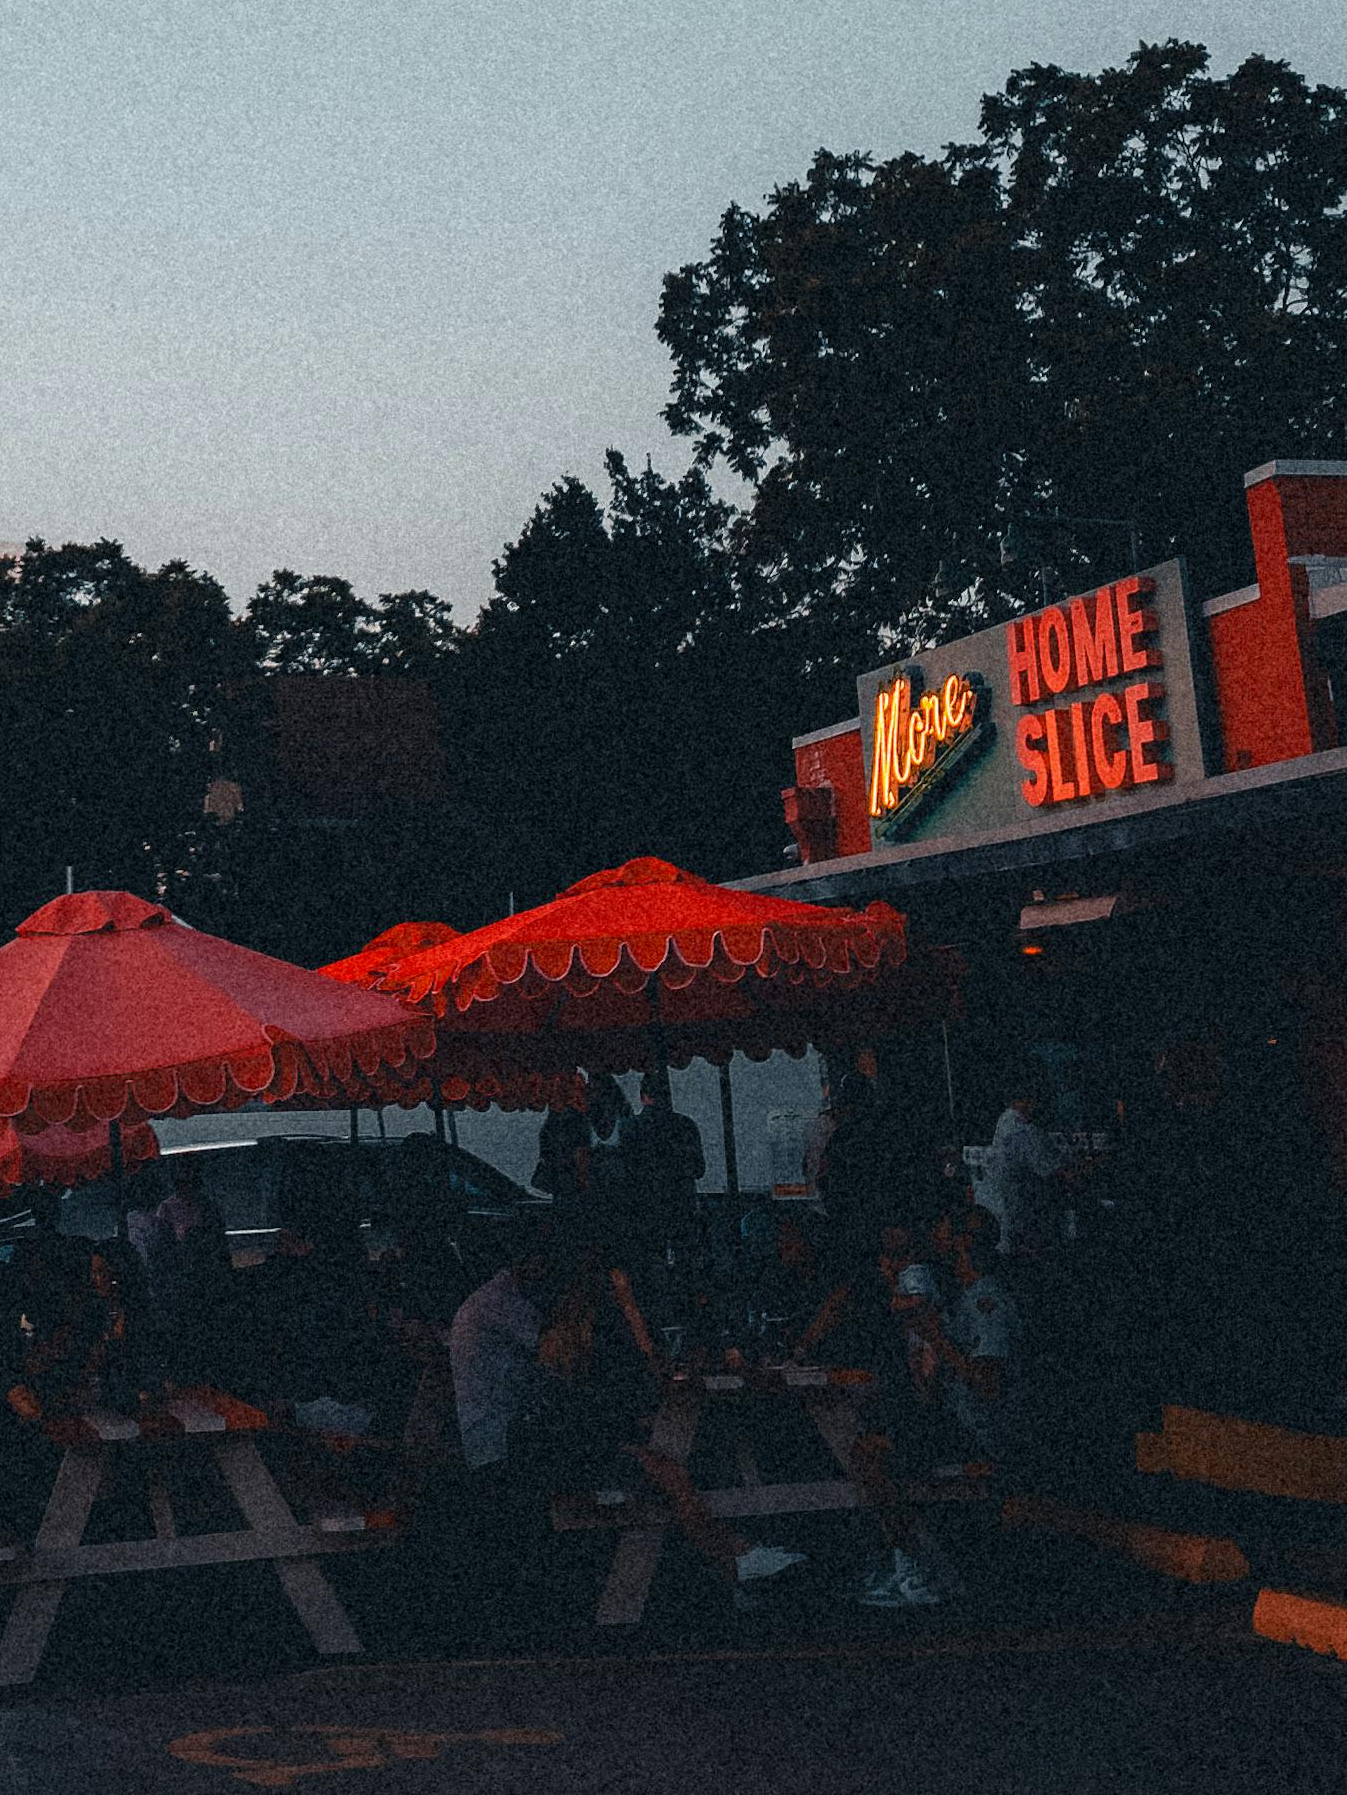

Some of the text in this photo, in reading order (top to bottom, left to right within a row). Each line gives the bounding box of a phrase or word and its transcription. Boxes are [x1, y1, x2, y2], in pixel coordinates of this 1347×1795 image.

[1006, 576, 1148, 706] HOME
[869, 672, 975, 818] More
[1016, 682, 1159, 807] SLICE
